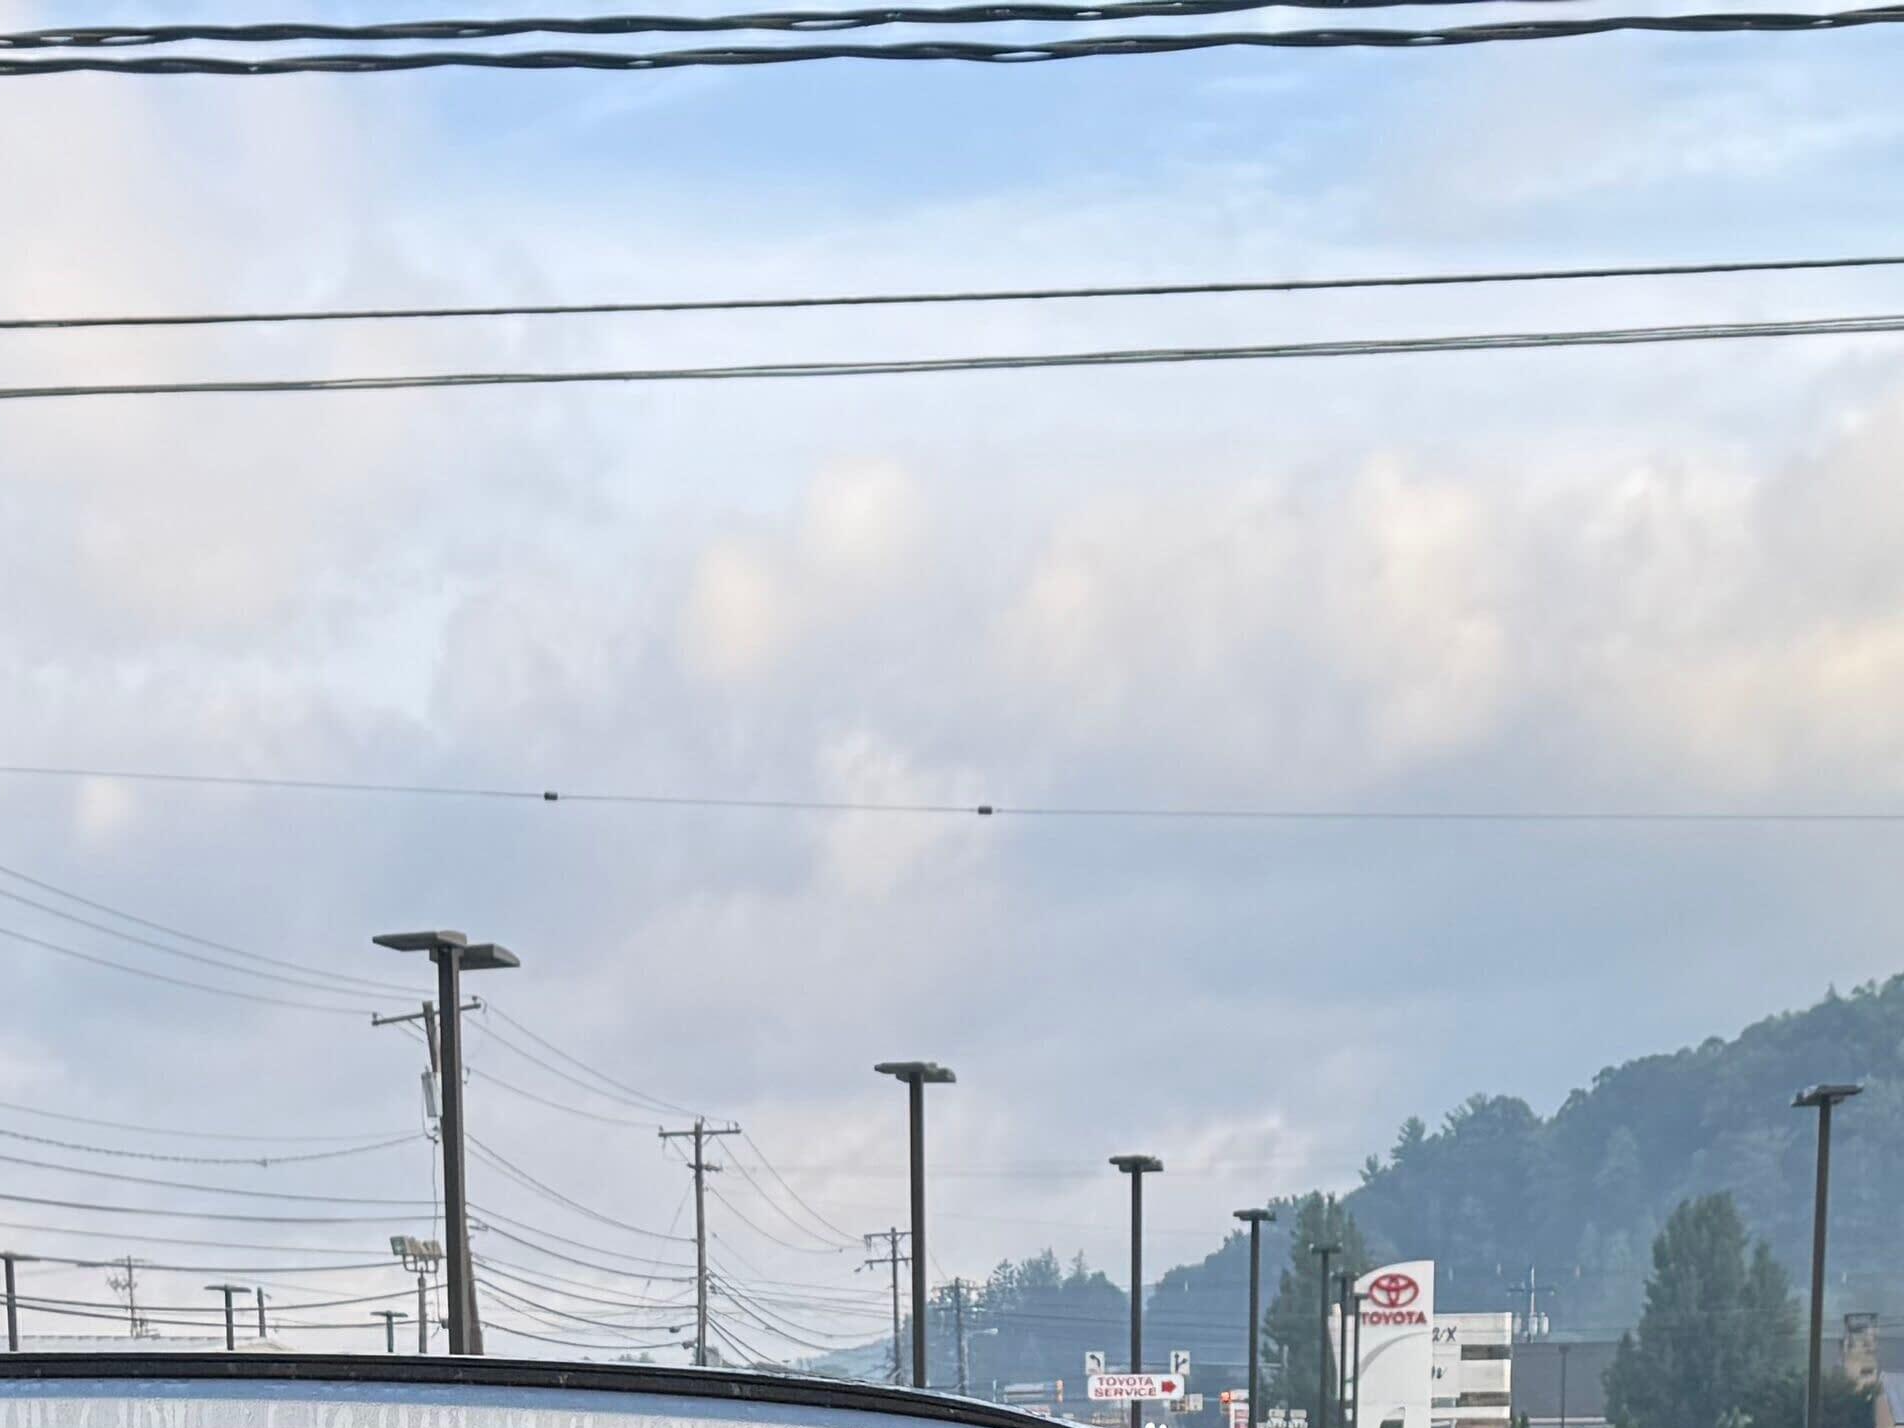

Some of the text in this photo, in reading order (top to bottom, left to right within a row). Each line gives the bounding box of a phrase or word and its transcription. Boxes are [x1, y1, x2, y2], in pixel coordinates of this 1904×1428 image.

[1361, 1311, 1427, 1326] TOYOTA
[1098, 1376, 1154, 1386] TOYOTA
[1094, 1387, 1157, 1397] SERVICE
